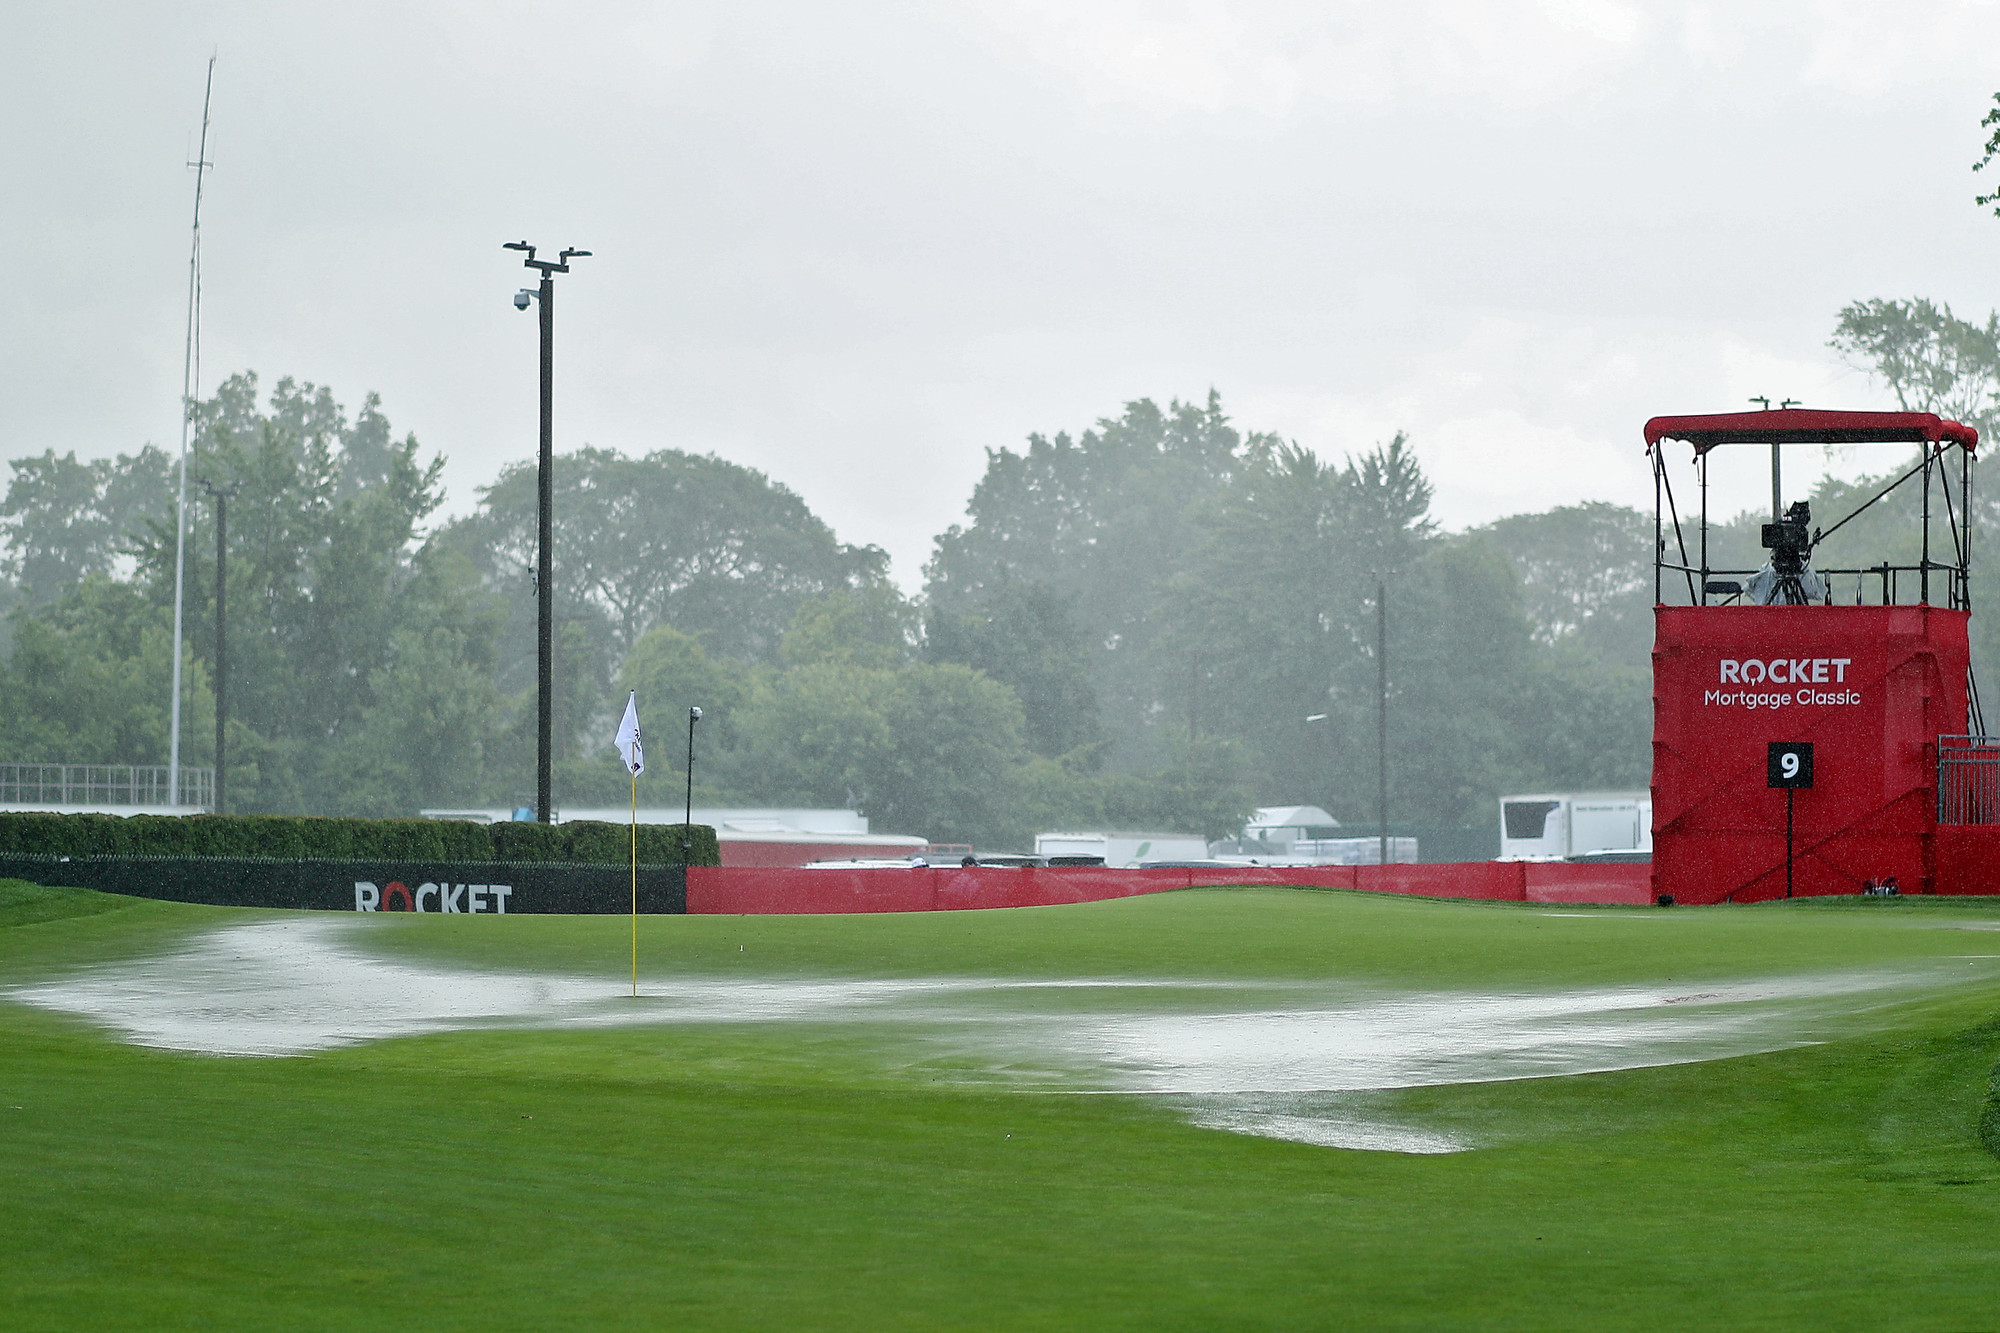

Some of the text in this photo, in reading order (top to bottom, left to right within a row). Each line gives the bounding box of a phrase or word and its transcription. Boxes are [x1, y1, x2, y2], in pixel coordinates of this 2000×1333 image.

[1720, 658, 1851, 686] ROCKET
[1704, 688, 1861, 710] Mortgage Classic
[1781, 752, 1800, 779] 9
[354, 881, 513, 914] ROCKET
